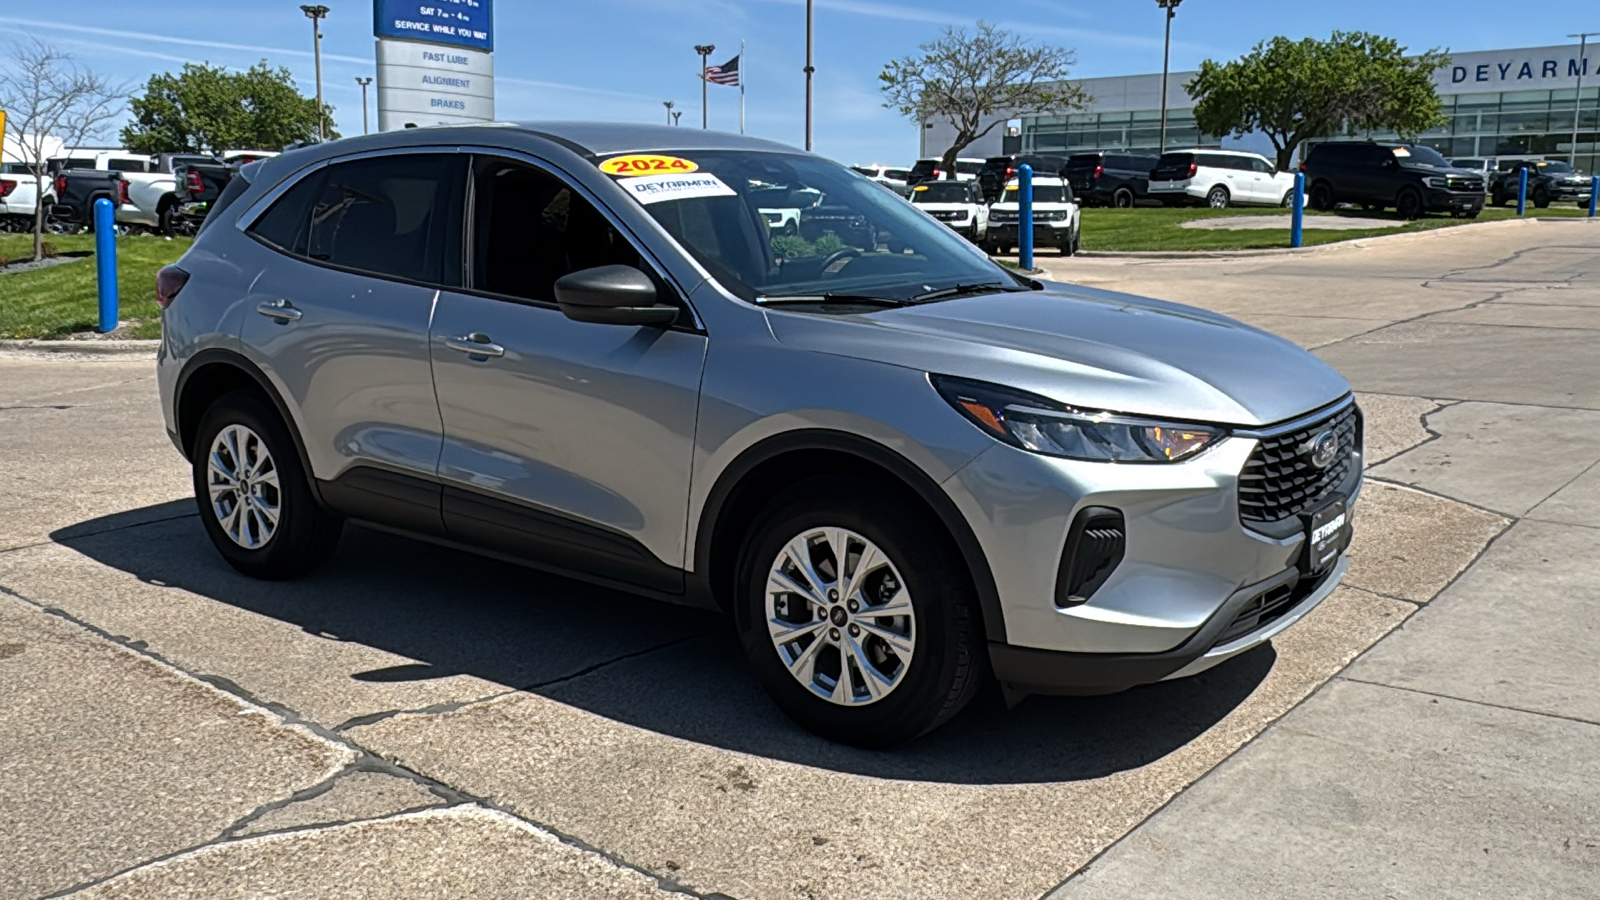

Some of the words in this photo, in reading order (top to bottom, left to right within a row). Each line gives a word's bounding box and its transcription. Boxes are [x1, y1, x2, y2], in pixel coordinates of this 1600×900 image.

[420, 6, 435, 16] SAT
[395, 20, 430, 32] SERVICE
[432, 24, 456, 35] WHILE
[458, 28, 471, 38] YOU
[473, 31, 487, 40] WAIT
[423, 51, 445, 62] FAST
[446, 55, 468, 65] LUBE
[1452, 58, 1600, 84] DEYARM
[422, 75, 470, 88] ALIGNMENT
[430, 98, 465, 110] BRAKES
[612, 159, 690, 173] 2024
[634, 179, 718, 193] DEYARMAN
